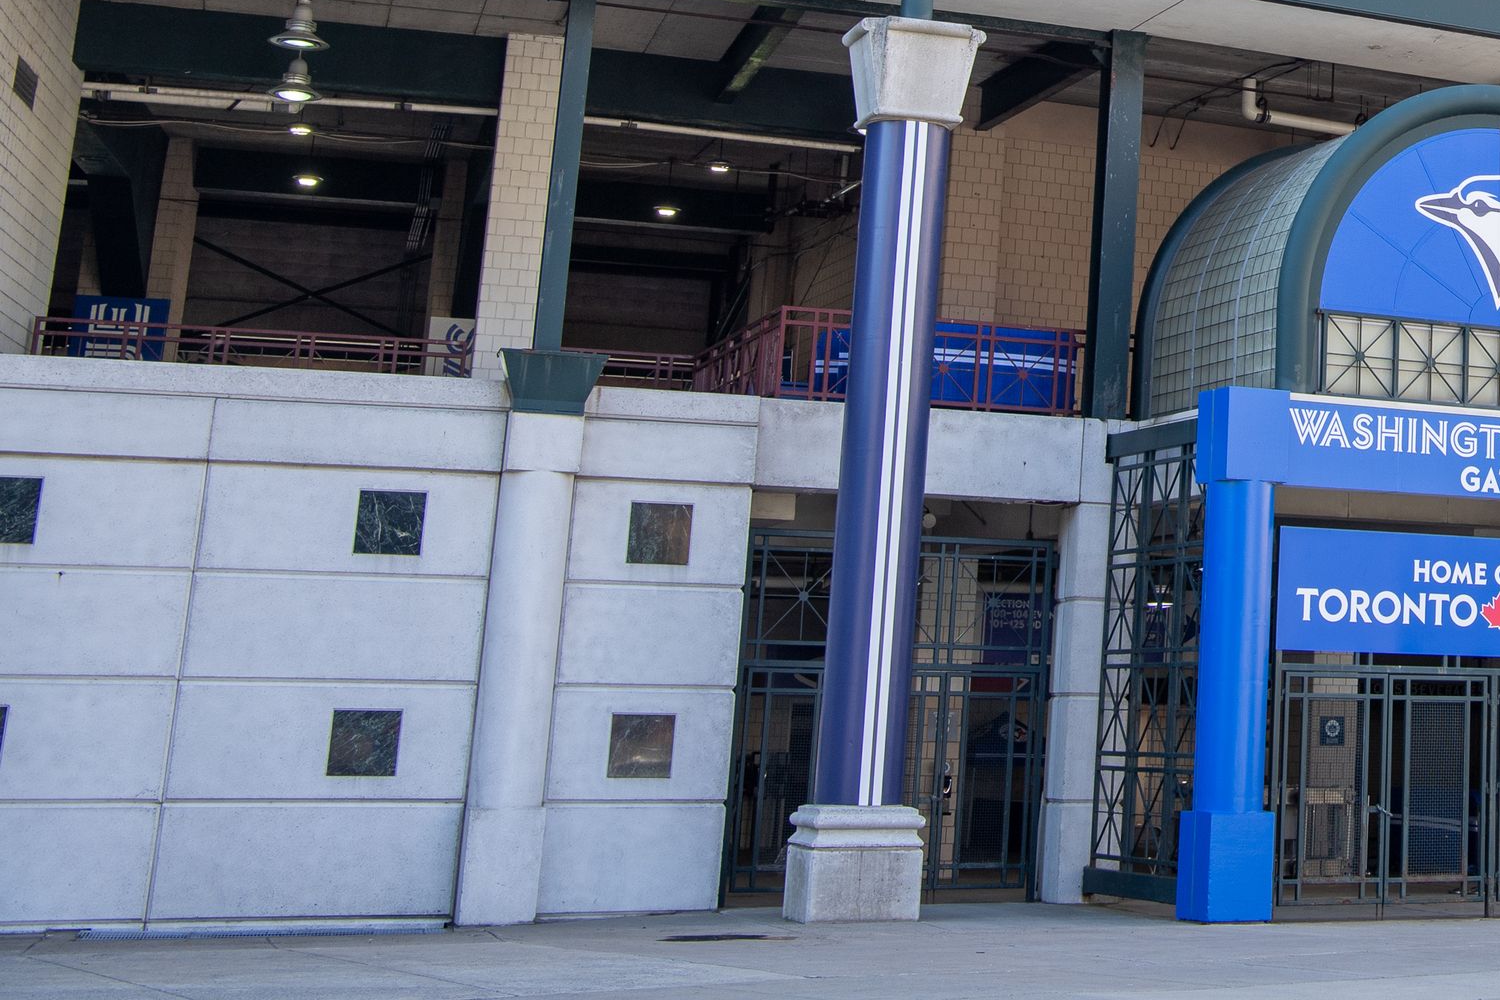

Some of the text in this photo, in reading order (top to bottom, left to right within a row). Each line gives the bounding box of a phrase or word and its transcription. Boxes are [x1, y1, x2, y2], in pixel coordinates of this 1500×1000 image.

[1413, 559, 1487, 585] HOME
[990, 599, 1030, 609] ECTION
[1296, 587, 1478, 627] TORONTO
